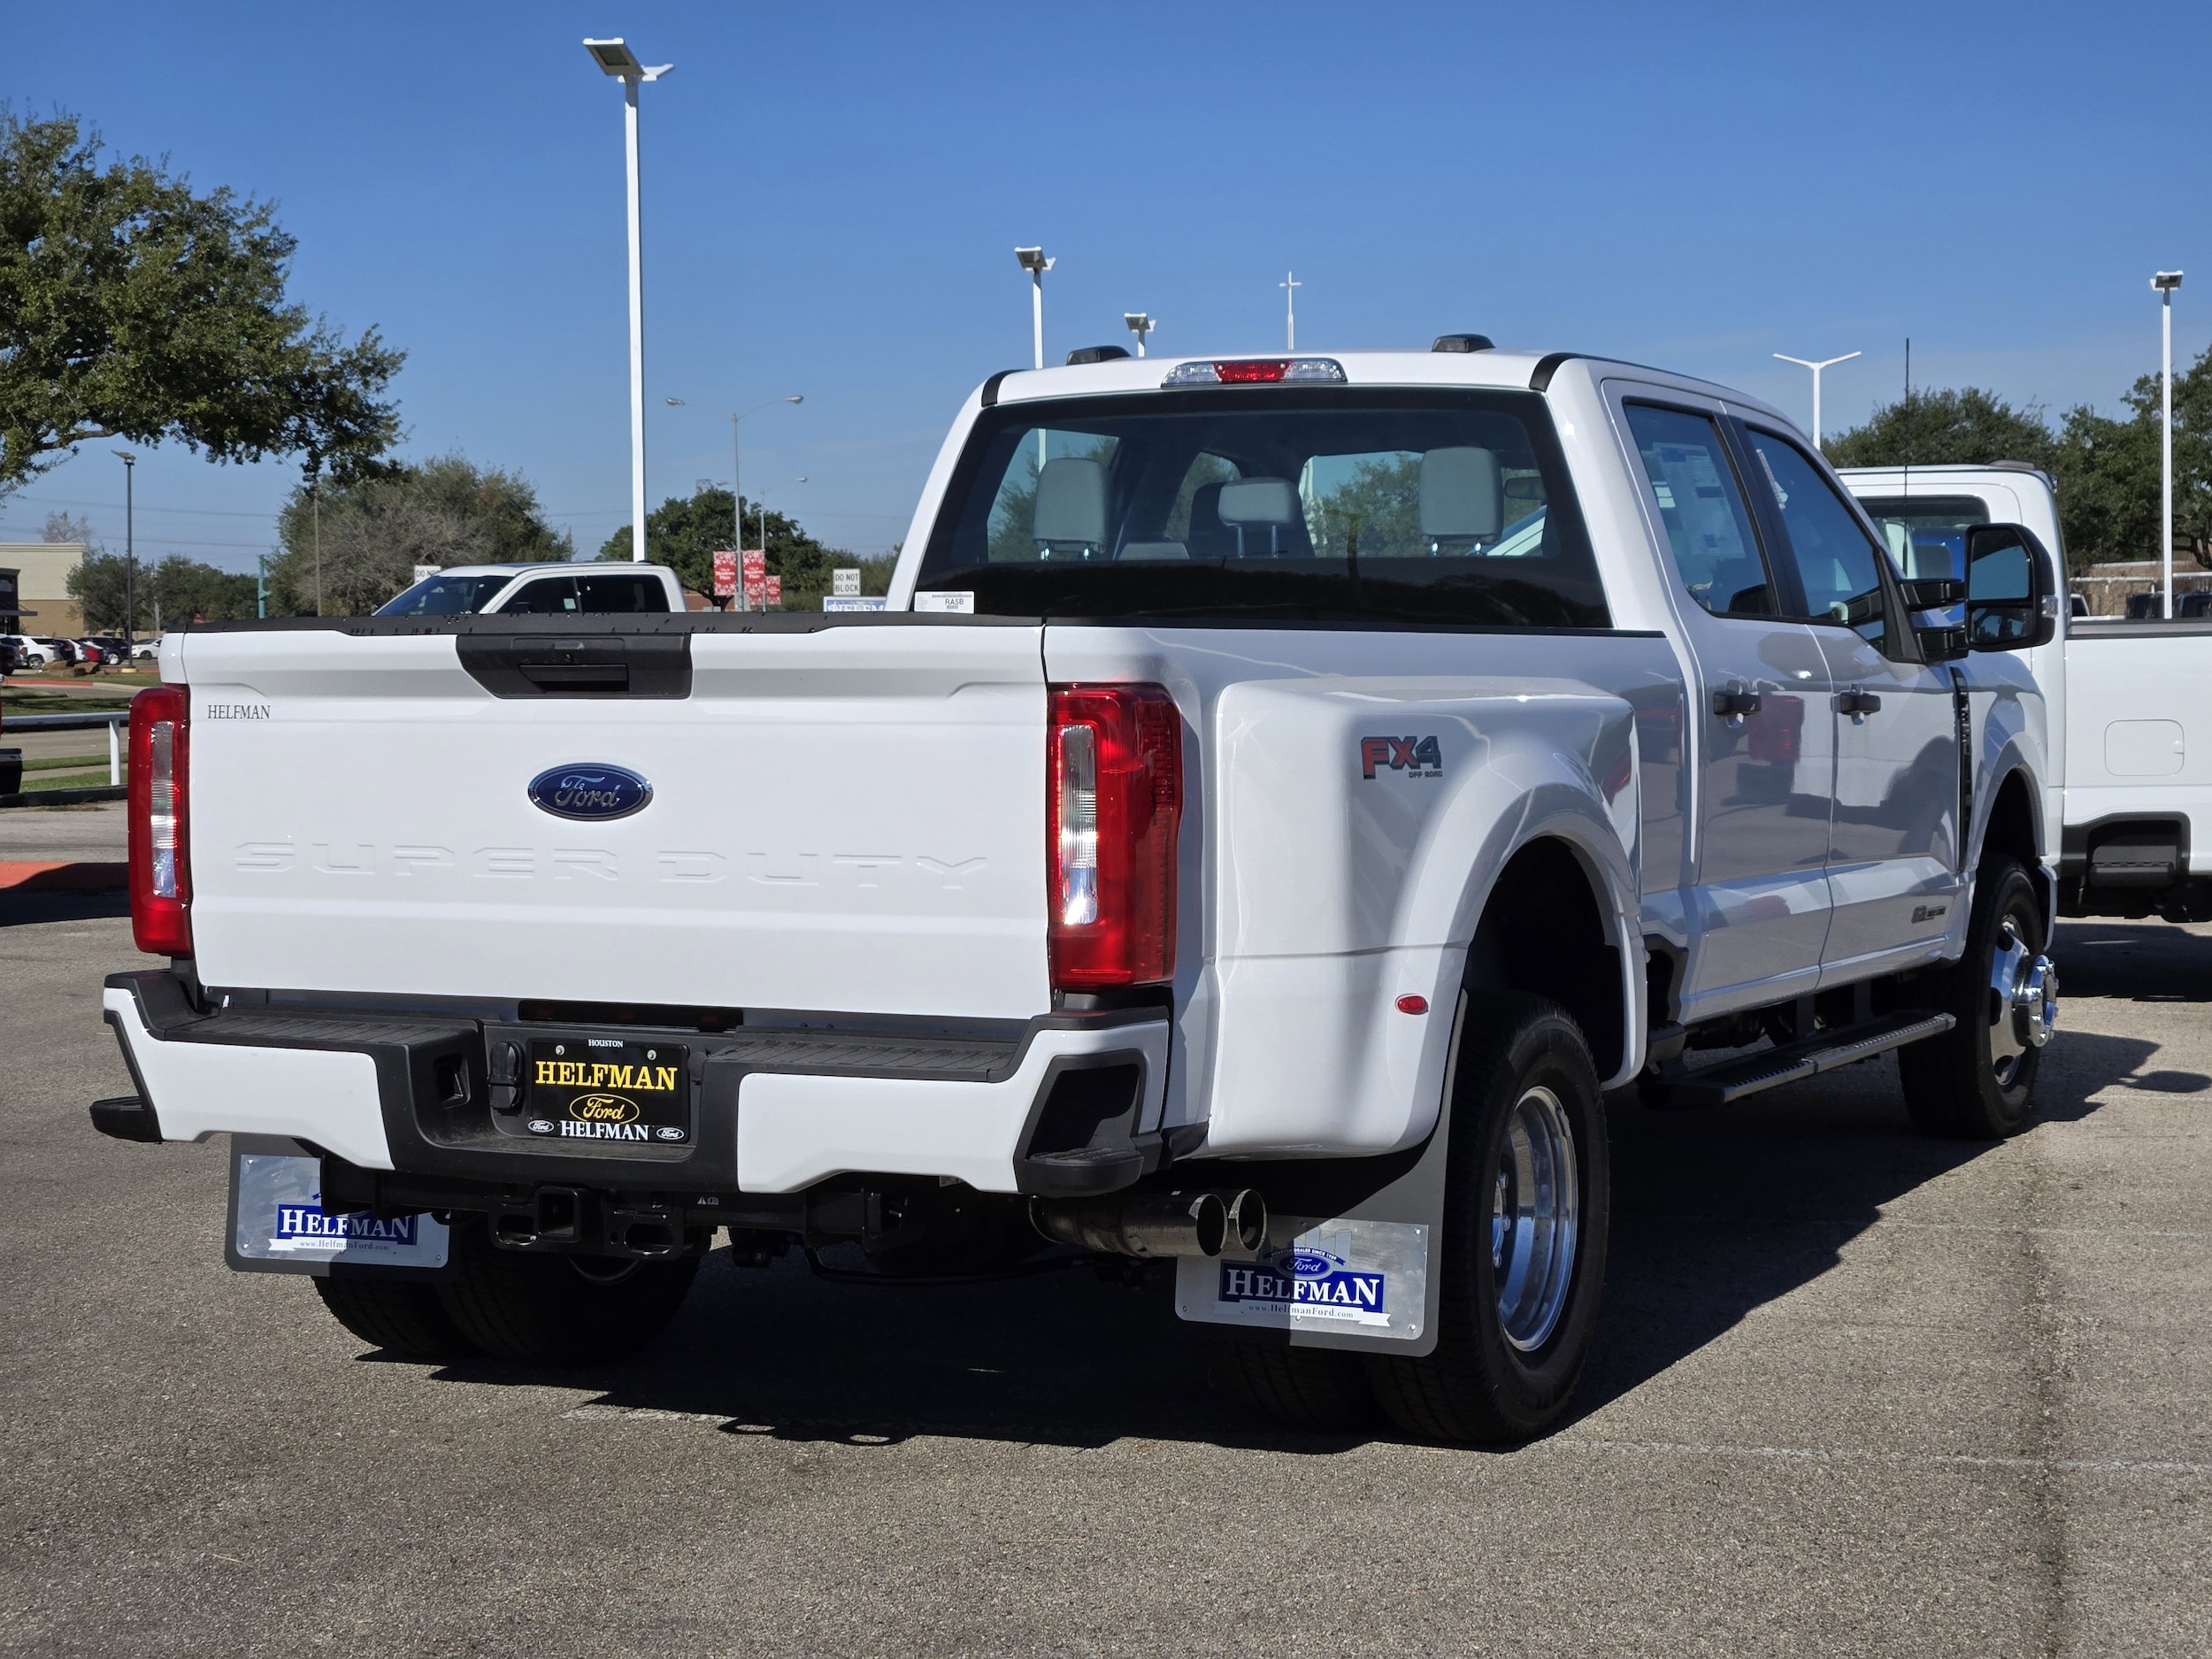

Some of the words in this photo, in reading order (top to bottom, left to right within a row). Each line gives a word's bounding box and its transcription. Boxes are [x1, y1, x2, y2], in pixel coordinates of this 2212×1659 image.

[835, 572, 844, 581] DO
[846, 572, 859, 581] NOT
[207, 704, 272, 719] HELFMAN
[1361, 736, 1441, 779] FX4
[553, 774, 621, 809] Ford
[235, 841, 618, 881] SUPER
[657, 849, 987, 890] DUTY
[588, 1039, 624, 1048] HOUSTON
[534, 1061, 679, 1091] HELFMAN
[582, 1096, 626, 1120] Ford
[559, 1119, 649, 1141] HELFMAN
[280, 1210, 411, 1238] HELFMAN
[300, 1240, 389, 1251] www.HelfmanFord.com
[1287, 1256, 1322, 1272] Ford
[1226, 1269, 1379, 1305] HELFMAN
[1248, 1304, 1354, 1317] www.HelfmanFord.com
